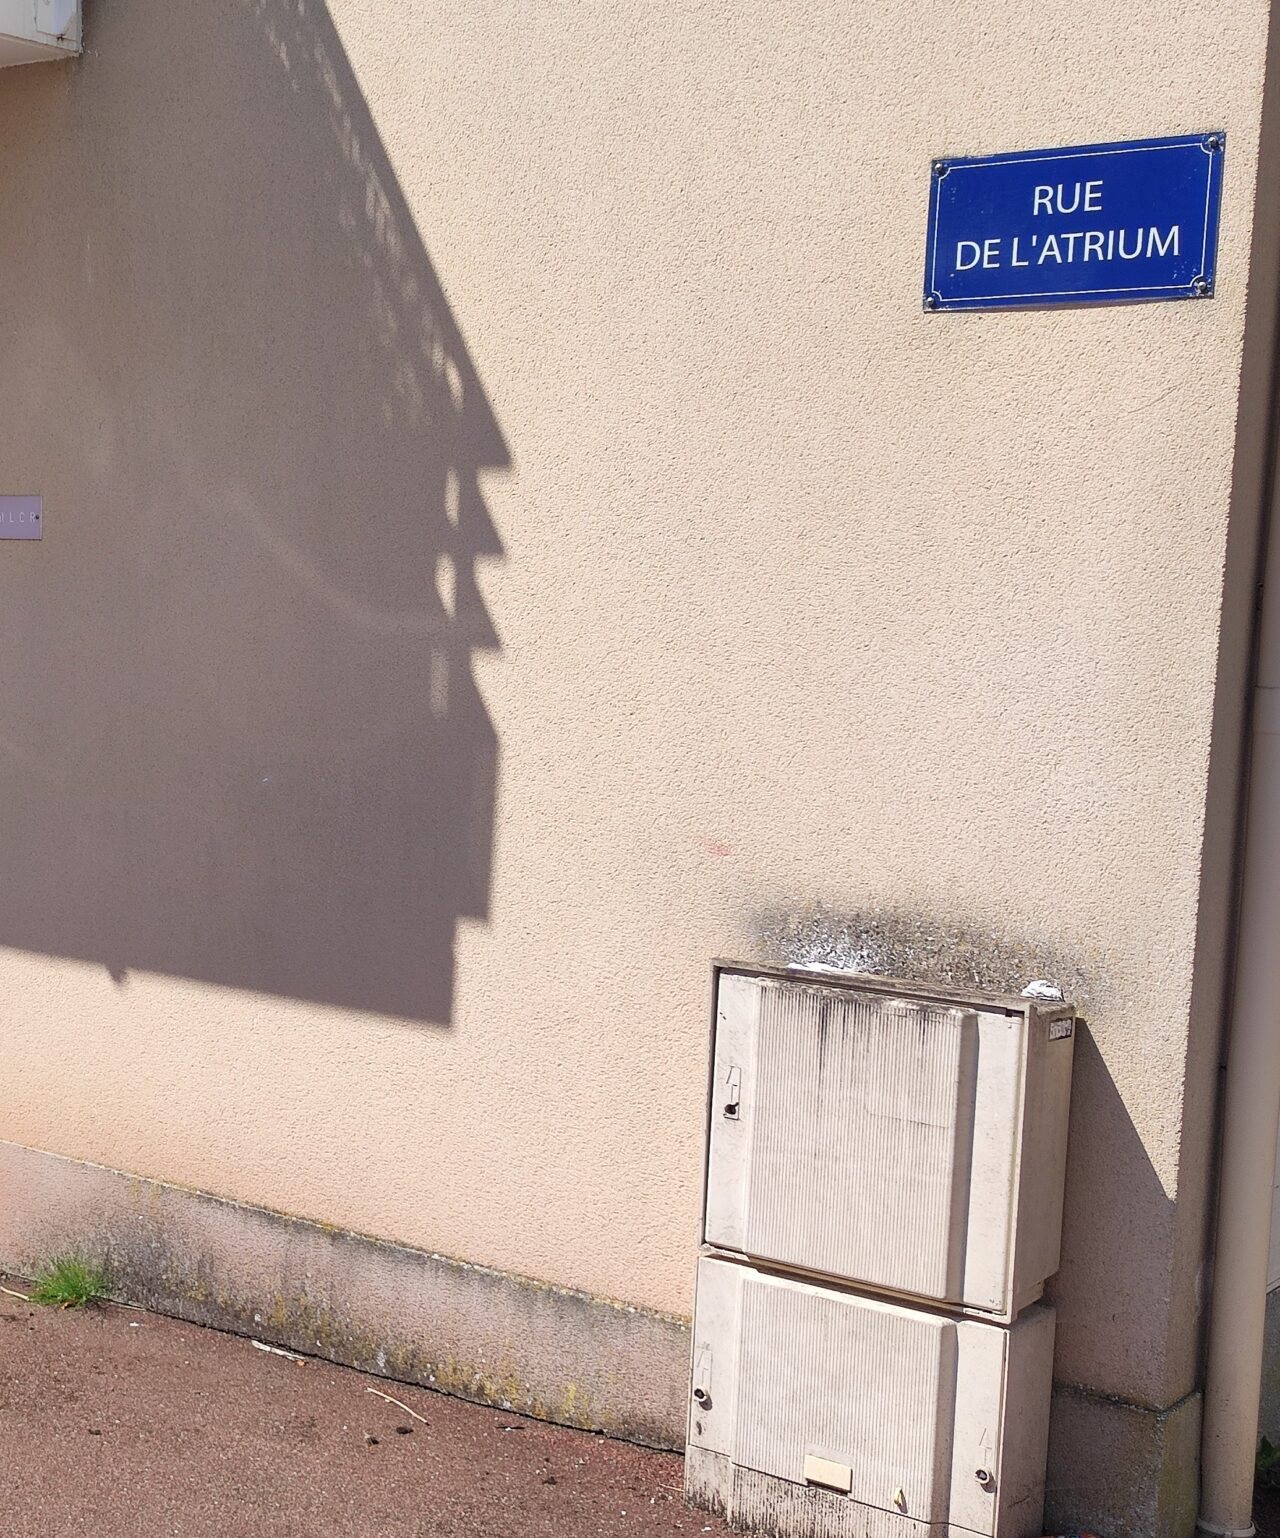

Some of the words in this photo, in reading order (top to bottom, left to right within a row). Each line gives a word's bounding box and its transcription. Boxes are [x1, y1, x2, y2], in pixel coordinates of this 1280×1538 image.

[1032, 180, 1104, 216] RUE
[955, 238, 1001, 271] DE
[1011, 225, 1180, 267] L'ATRIUM
